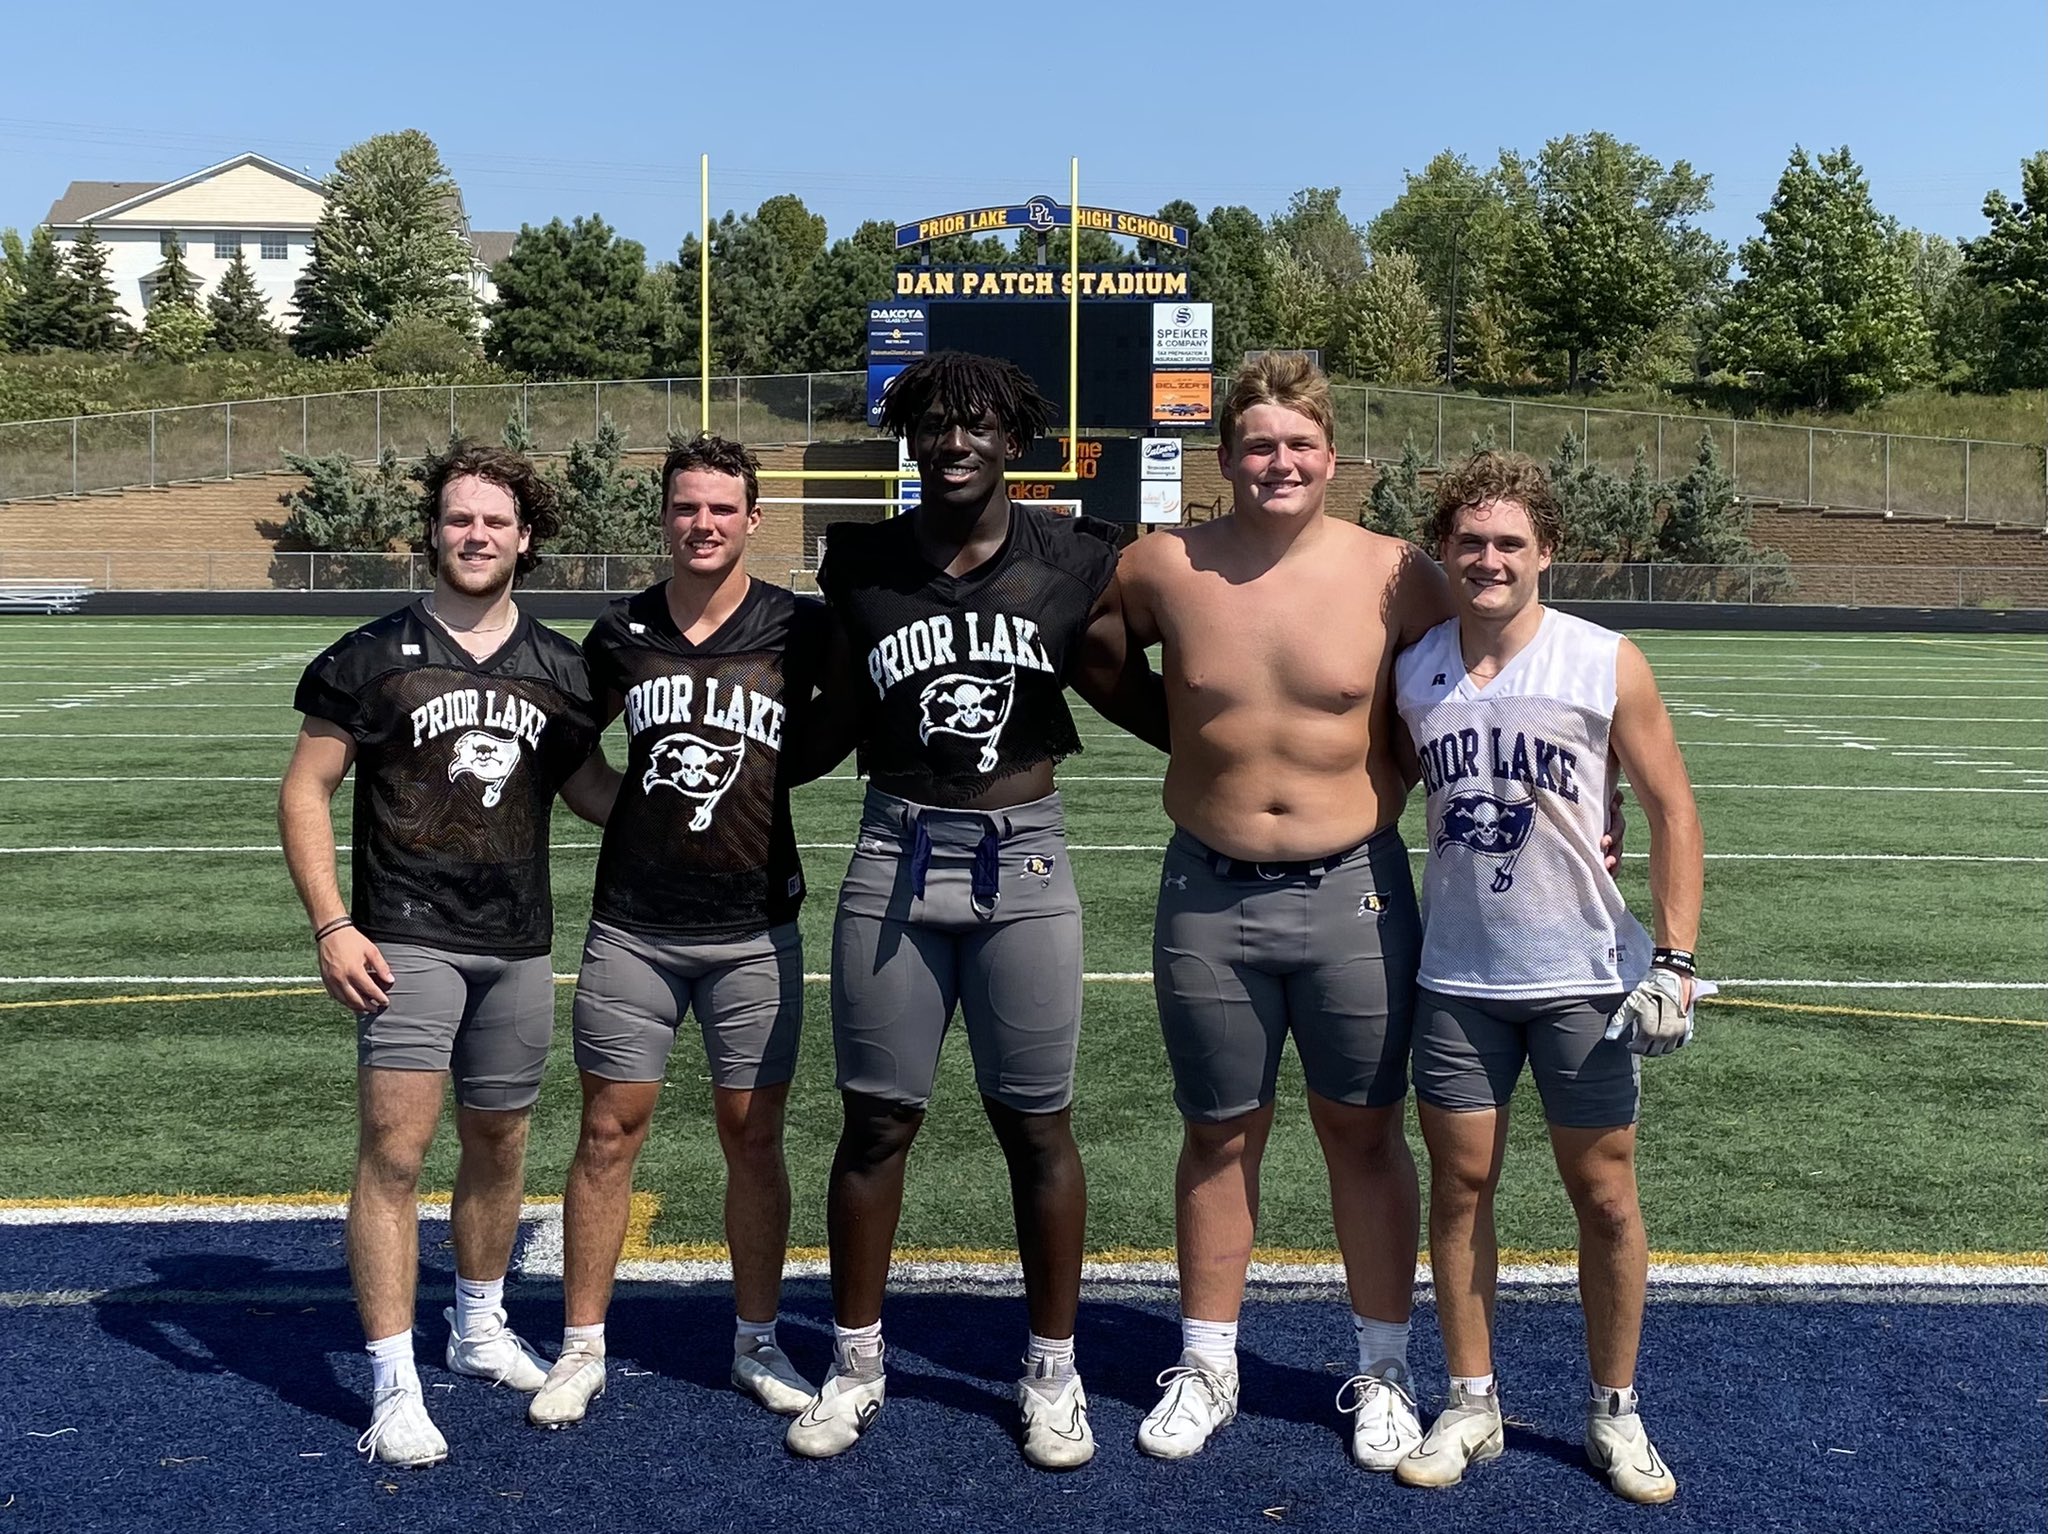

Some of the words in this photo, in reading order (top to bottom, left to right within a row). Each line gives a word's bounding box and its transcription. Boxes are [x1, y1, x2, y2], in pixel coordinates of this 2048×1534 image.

[919, 210, 966, 239] PRIOR
[970, 209, 1008, 228] LAKE
[1029, 202, 1054, 226] PL
[1077, 209, 1112, 228] HIGH
[1117, 214, 1178, 243] SCHOOL
[897, 272, 955, 295] DAN
[962, 272, 1054, 295] PATCH
[1061, 272, 1188, 295] STADIUM
[870, 309, 925, 319] DAKOTA
[1157, 328, 1208, 339] SPEIKER
[1058, 437, 1102, 458] Tme
[1008, 480, 1055, 499] aker
[867, 613, 956, 701] PRIOR
[410, 688, 480, 749] PRIOR
[485, 688, 547, 752] LAKE
[704, 677, 786, 751] LAKE
[1418, 727, 1480, 799] RIOR
[1491, 727, 1579, 806] LAKE
